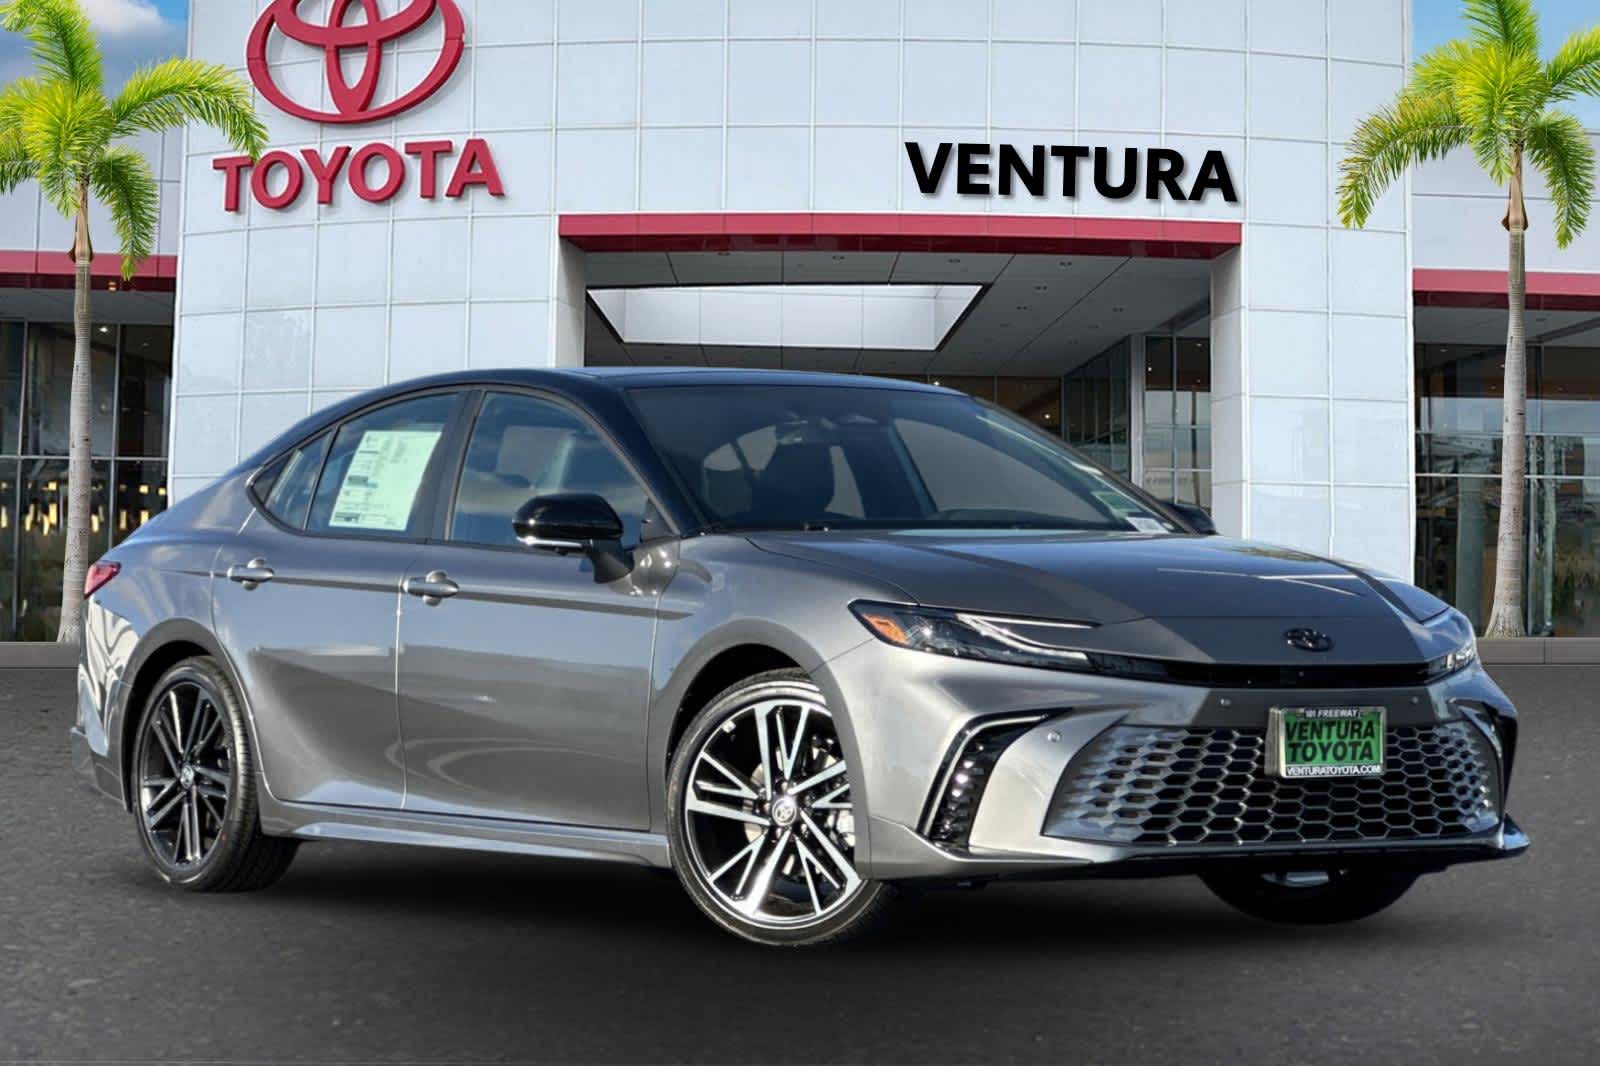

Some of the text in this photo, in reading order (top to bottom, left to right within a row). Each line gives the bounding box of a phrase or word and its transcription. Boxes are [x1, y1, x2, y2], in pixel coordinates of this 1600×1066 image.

[212, 138, 505, 212] TOYOTA
[904, 142, 1239, 203] VENTURA
[1286, 720, 1375, 740] VENTURA
[1288, 741, 1374, 762] TOYOTA
[1286, 765, 1381, 776] VENTURATOYOTA.COM
